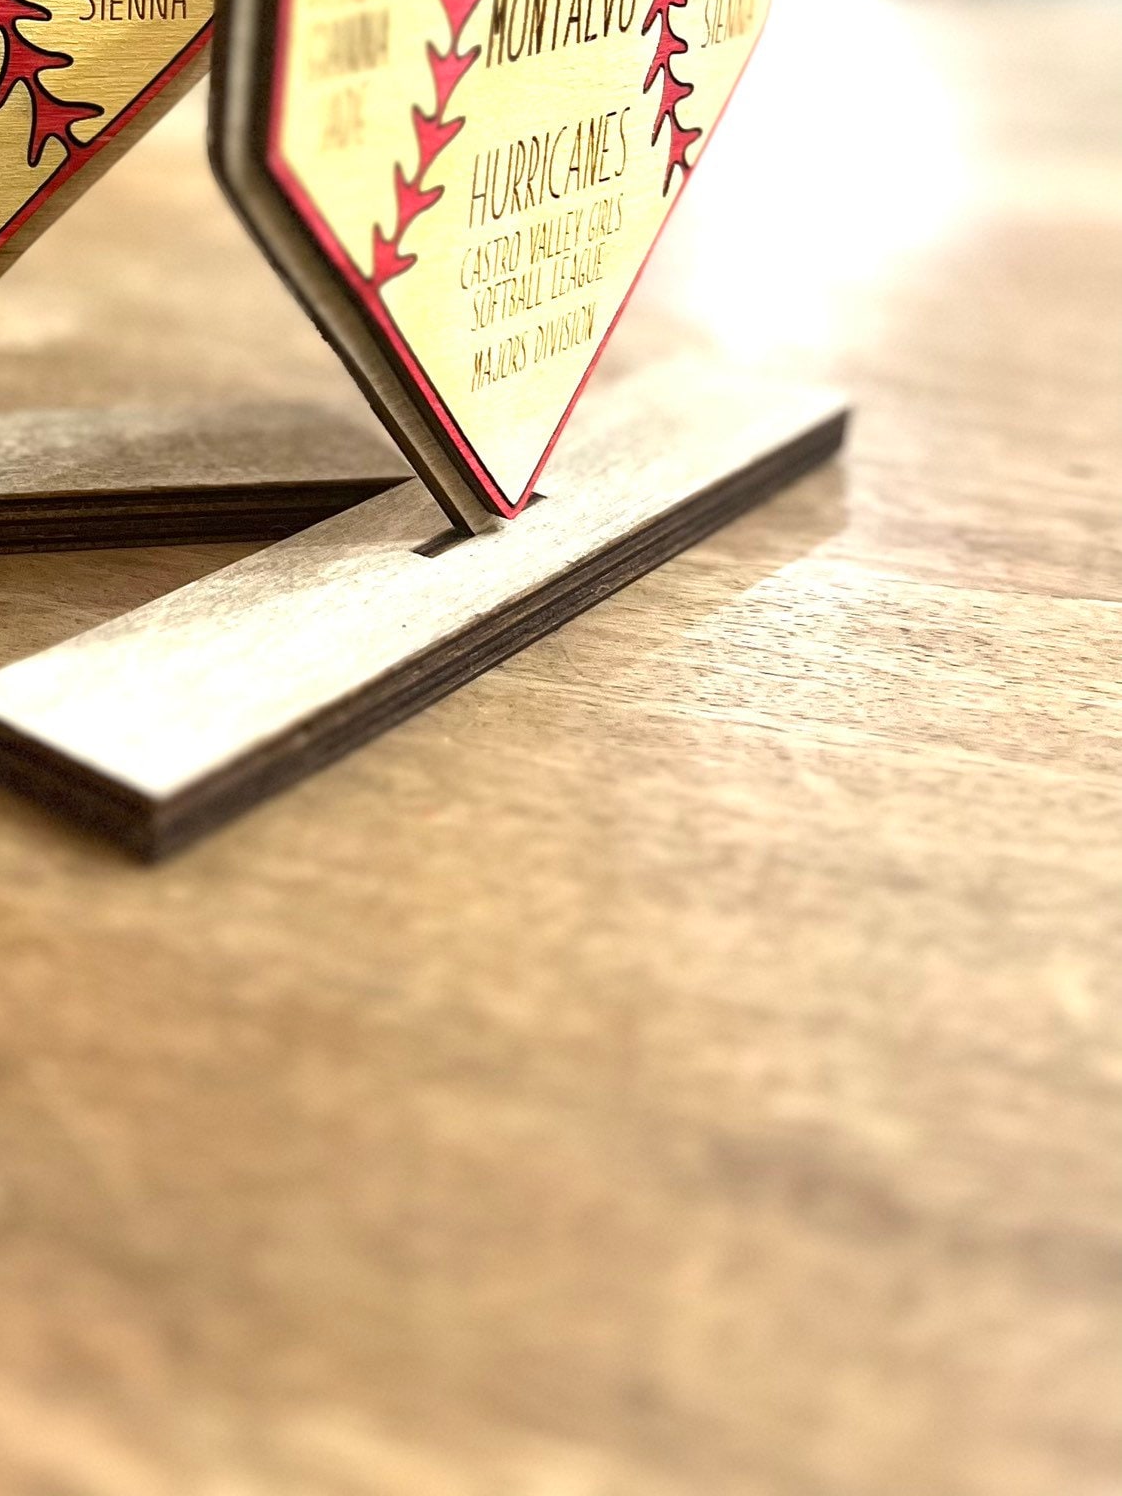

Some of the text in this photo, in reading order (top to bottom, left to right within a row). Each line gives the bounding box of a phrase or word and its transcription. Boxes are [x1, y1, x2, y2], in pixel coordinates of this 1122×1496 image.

[468, 106, 631, 229] HURRICANES
[459, 192, 624, 290] CASTRO VALLEY GIRLS
[471, 241, 606, 332] SOFTBALL LEAGUE
[471, 301, 597, 393] MAJORS DIVISION
